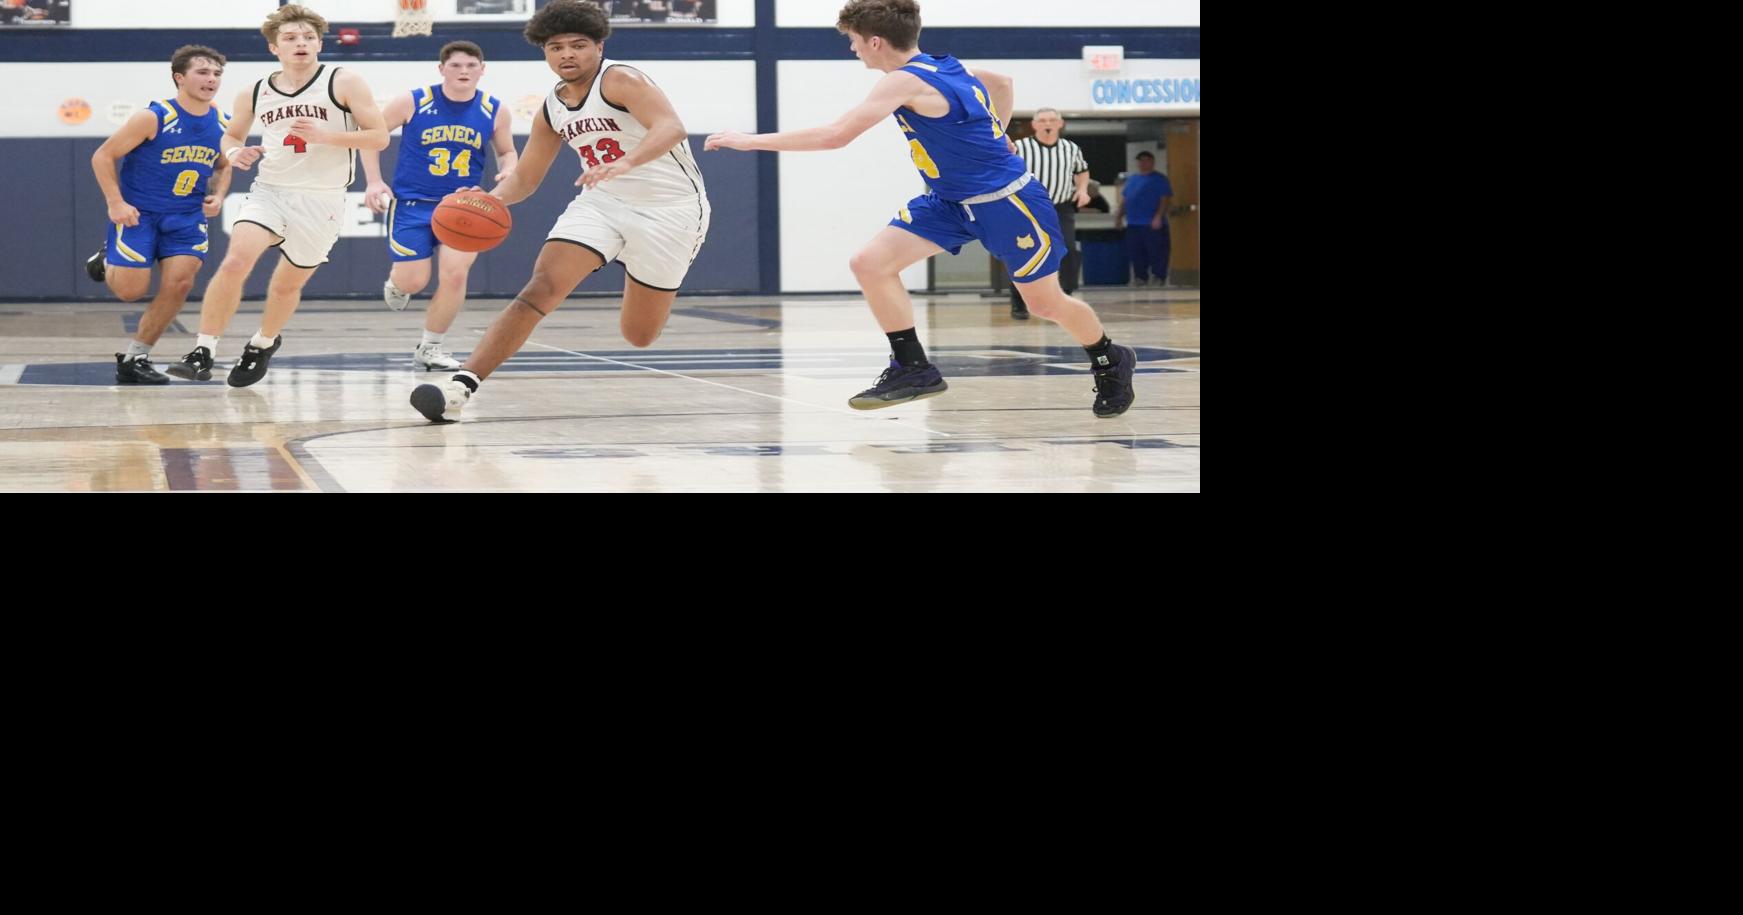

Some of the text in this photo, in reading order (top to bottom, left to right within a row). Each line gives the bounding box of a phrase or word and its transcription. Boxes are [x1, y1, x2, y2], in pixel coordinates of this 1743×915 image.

[260, 104, 329, 127] FRANKLIN
[421, 124, 482, 149] SENECA
[559, 117, 623, 142] RANKLIN
[283, 133, 307, 153] 4
[428, 147, 471, 177] 34
[172, 169, 200, 196] 0
